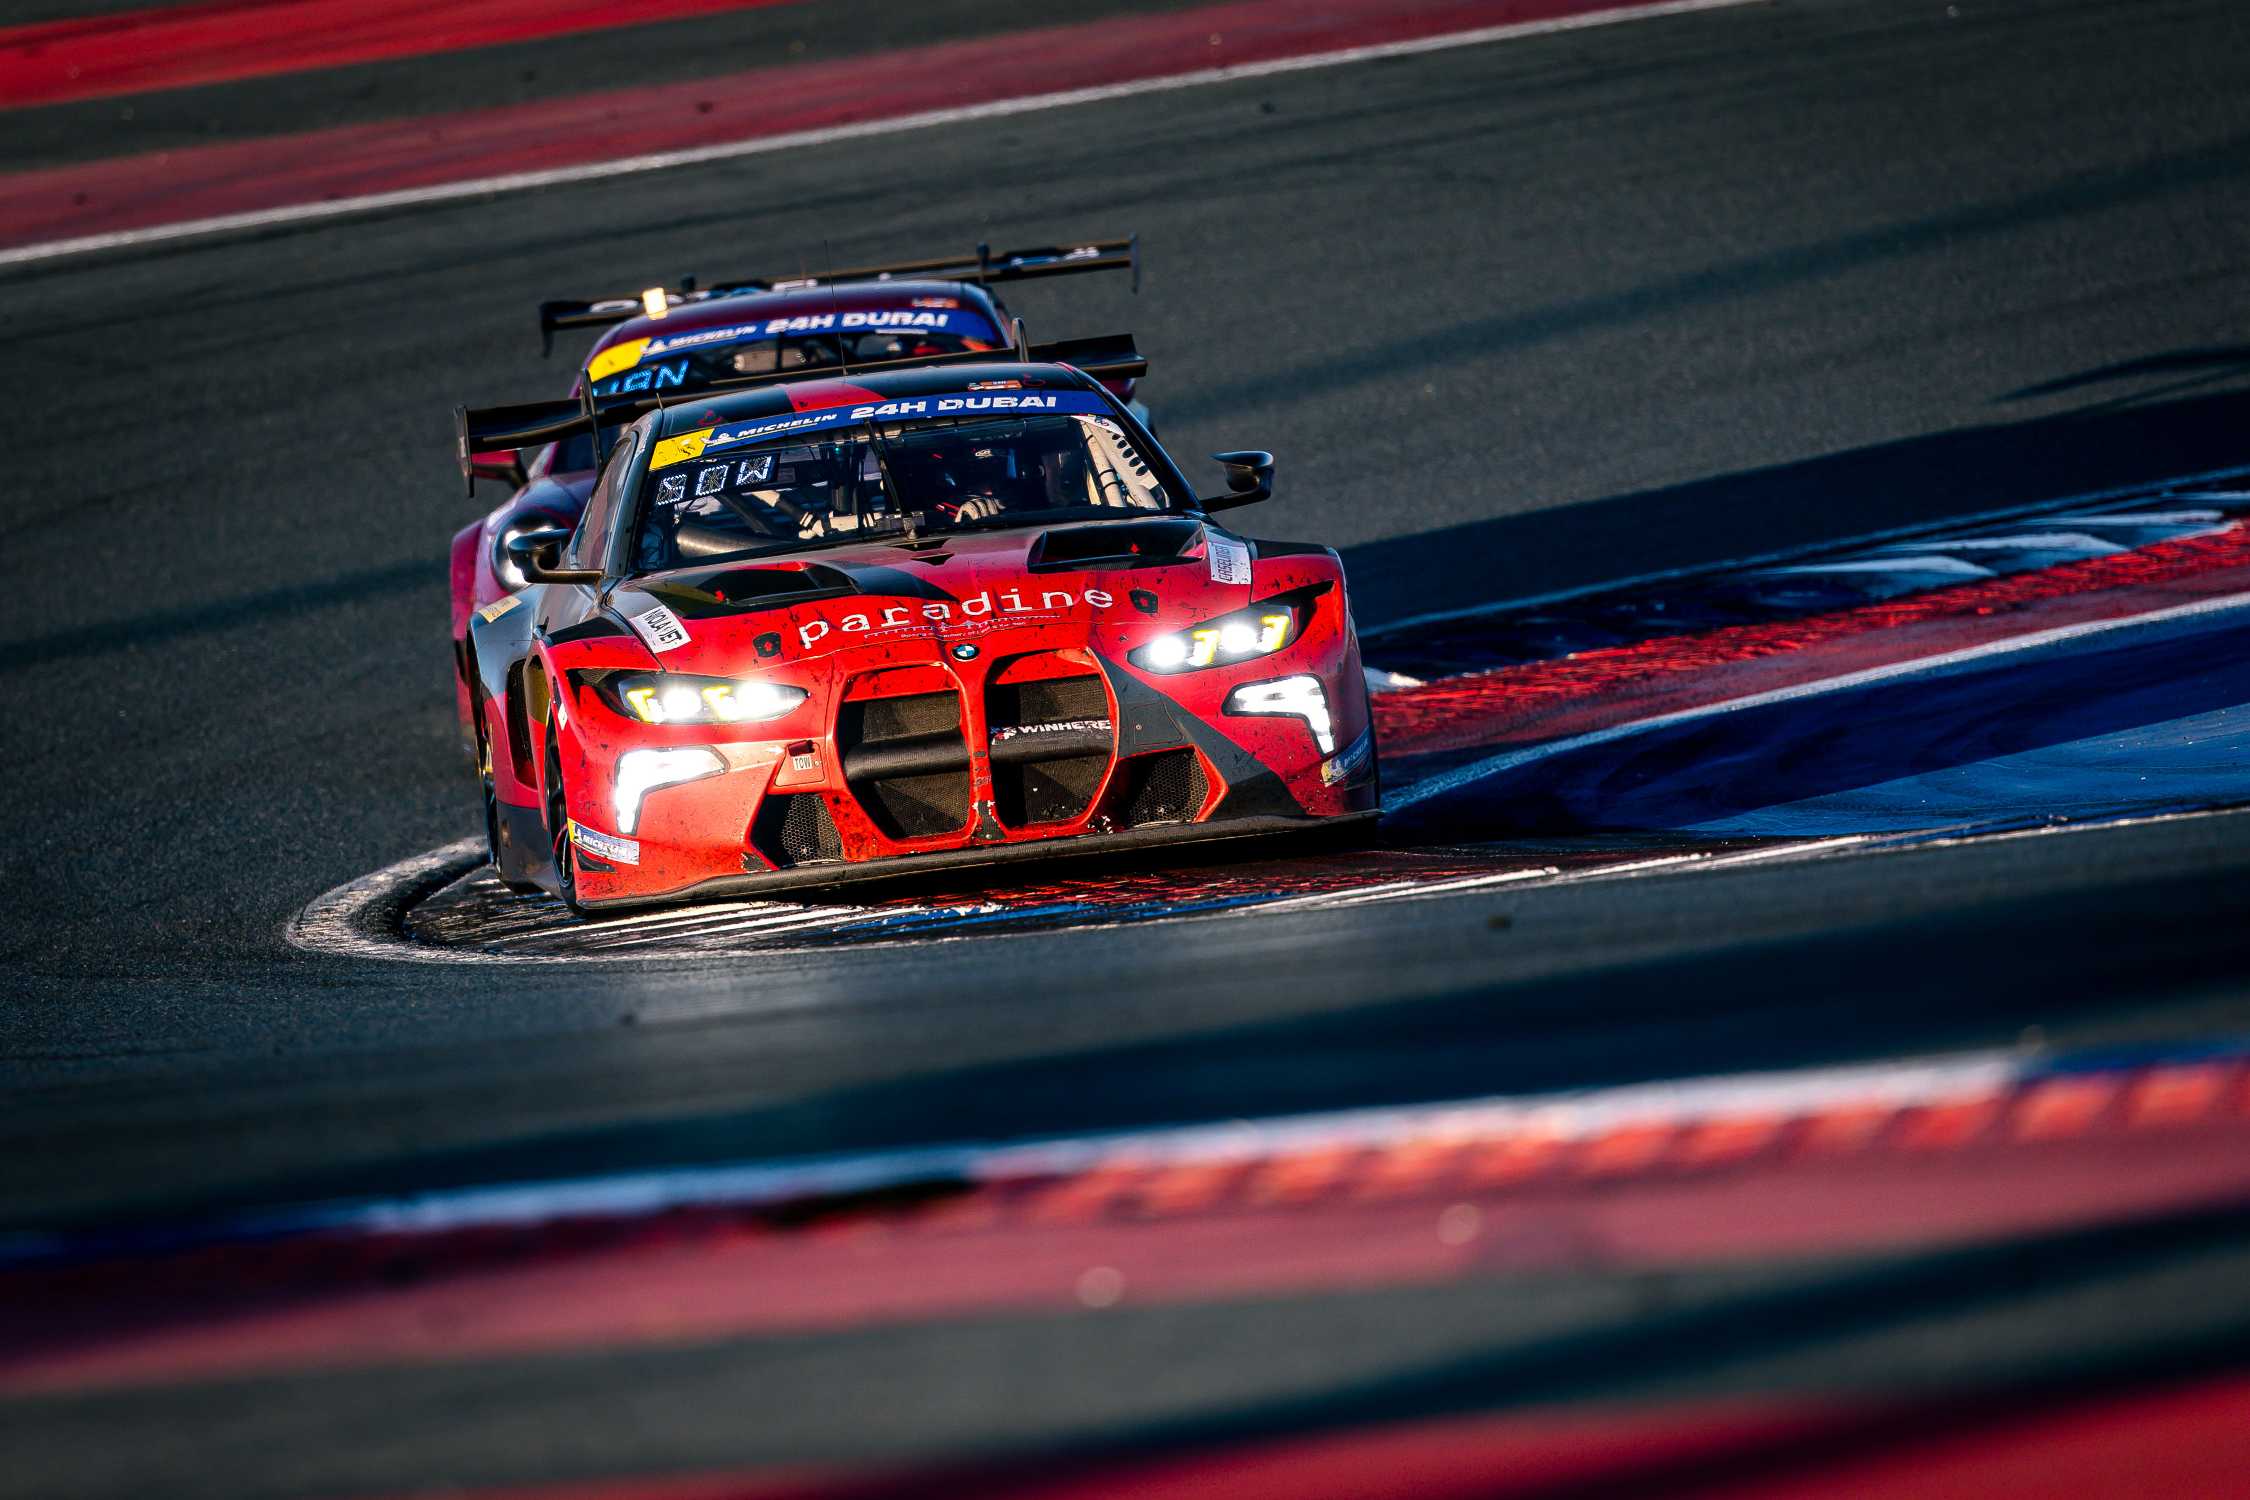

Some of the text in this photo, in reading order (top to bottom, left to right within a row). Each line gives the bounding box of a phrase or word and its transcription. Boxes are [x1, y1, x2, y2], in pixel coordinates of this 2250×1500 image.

[765, 313, 835, 334] 24H
[737, 396, 1057, 438] MICHELIN 24H DUBAI
[798, 588, 1113, 649] paradine
[1018, 720, 1112, 733] WINHERE
